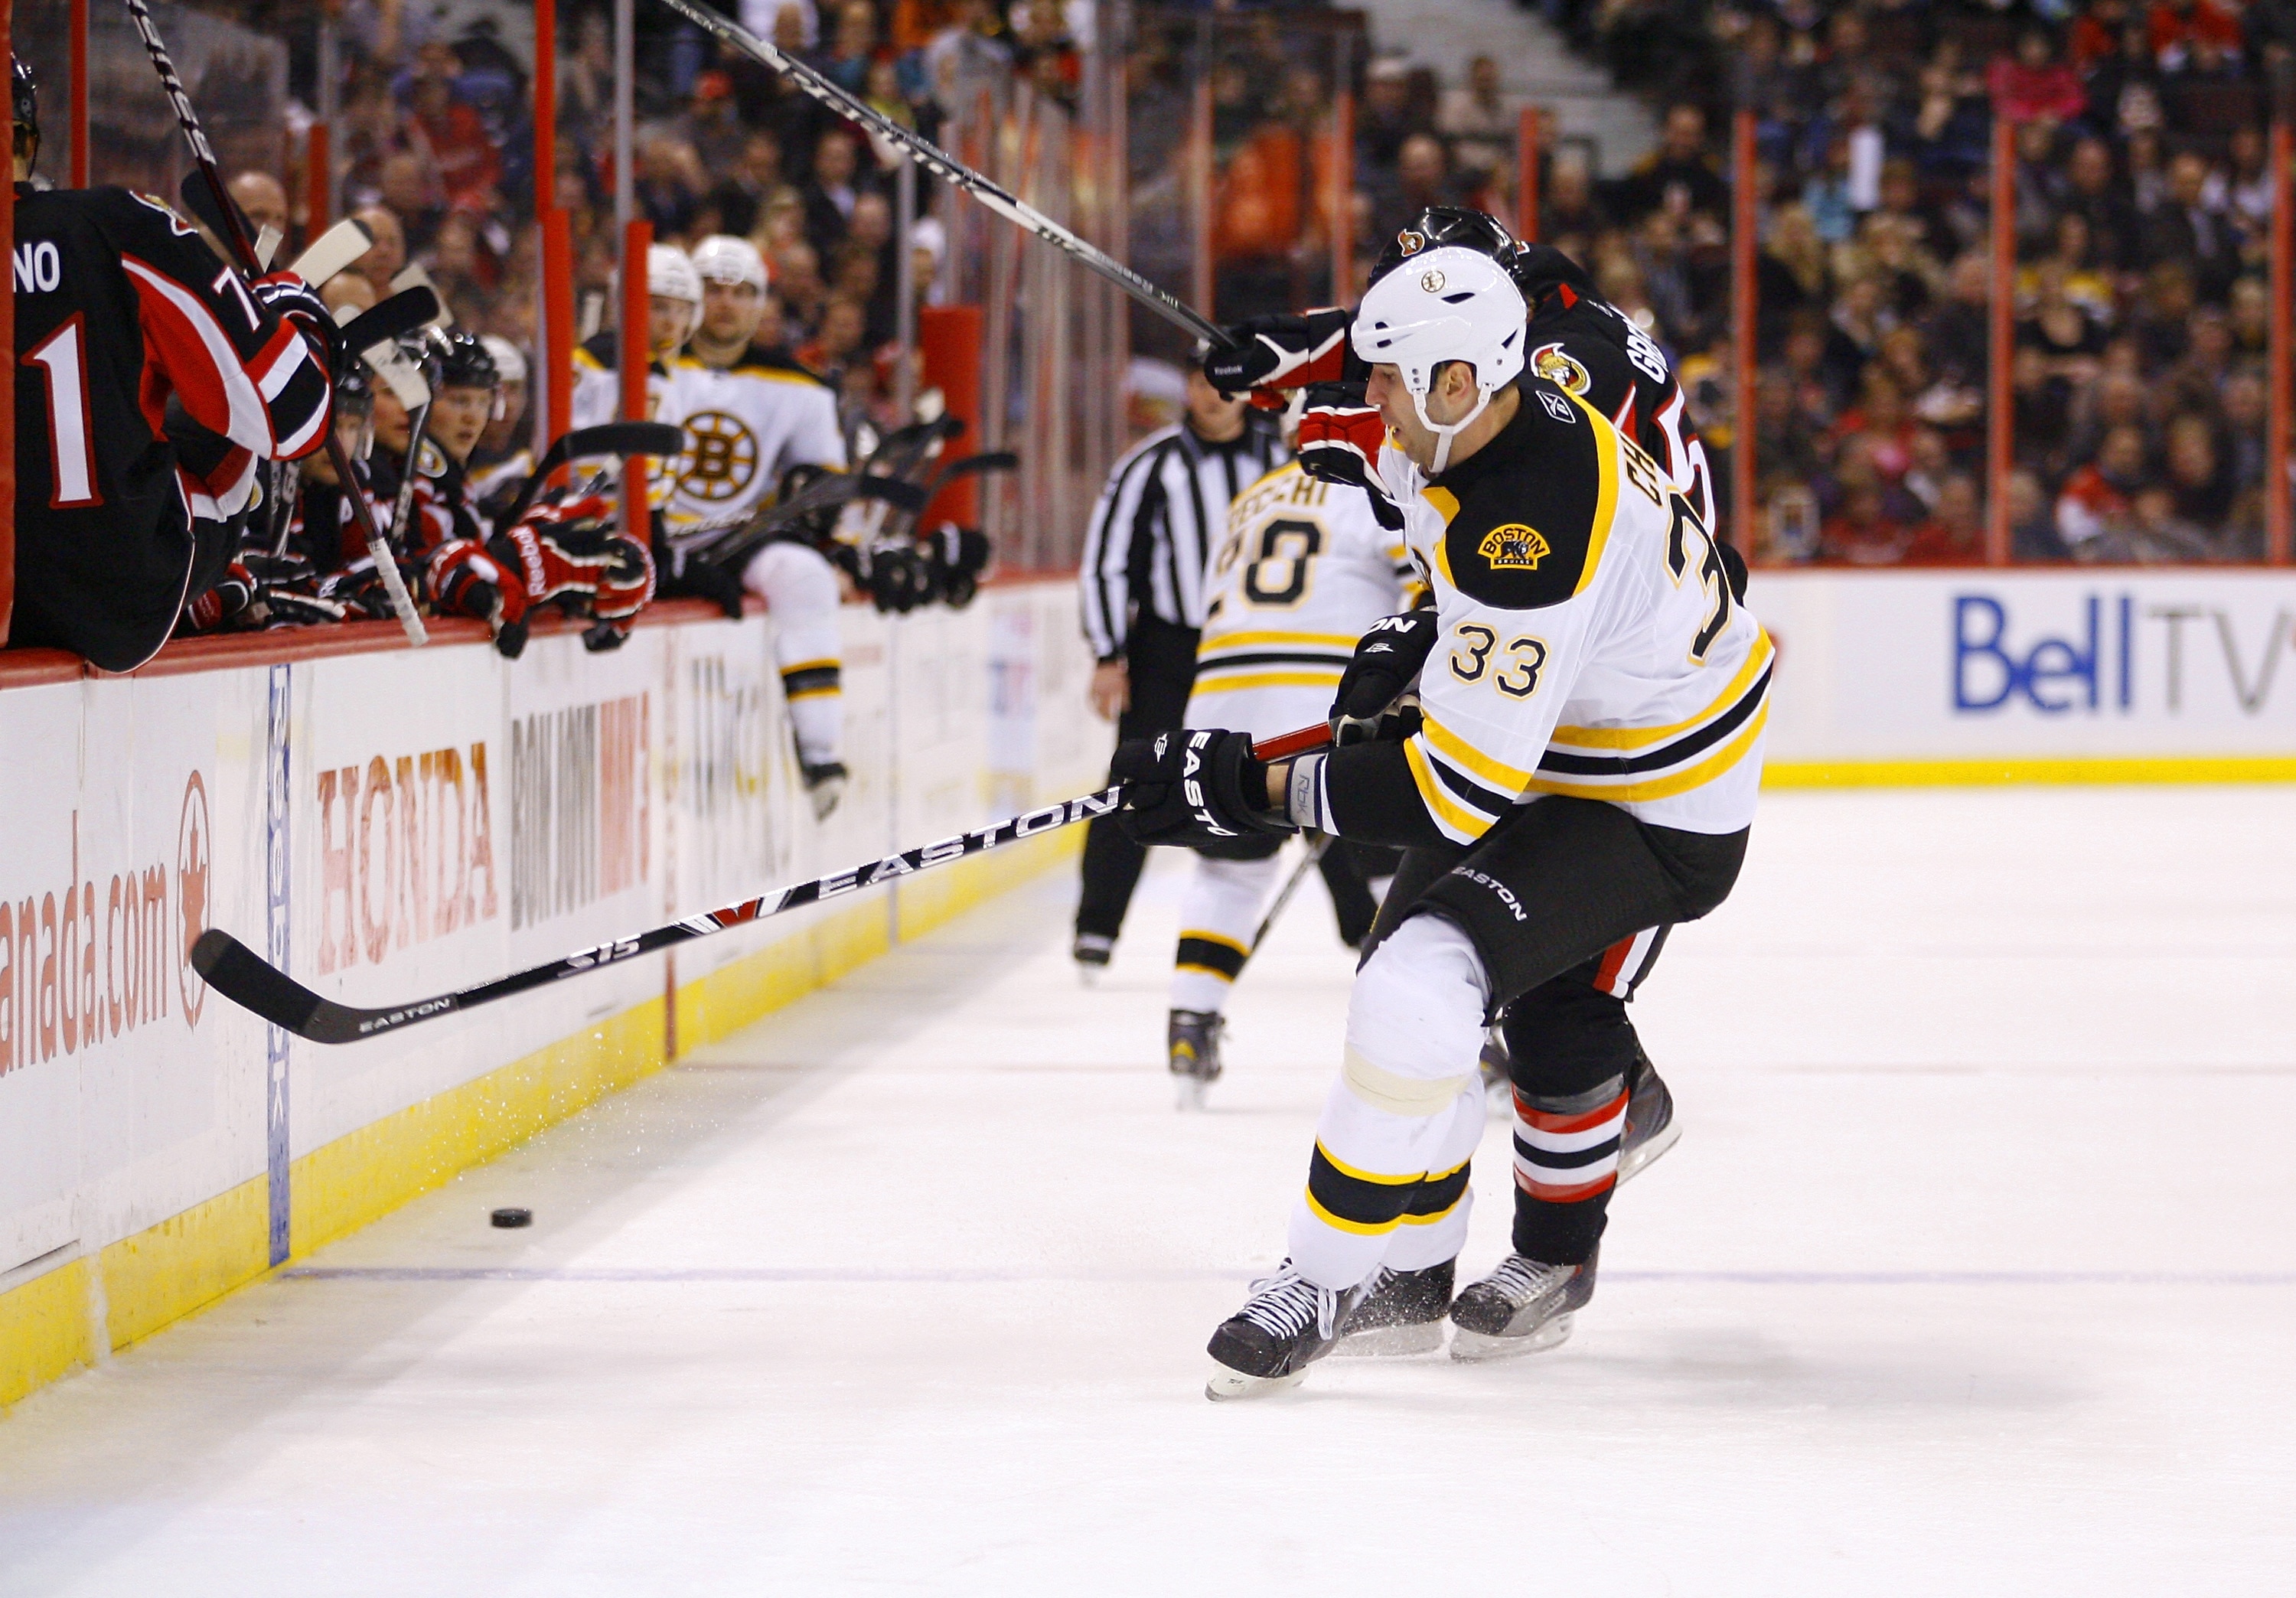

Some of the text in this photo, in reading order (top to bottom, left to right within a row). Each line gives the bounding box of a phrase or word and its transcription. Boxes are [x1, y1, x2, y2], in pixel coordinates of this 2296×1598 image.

[21, 311, 104, 510] 1
[1215, 365, 1243, 375] Reebok
[1483, 527, 1545, 555] BOSTON
[1448, 621, 1551, 703] 33
[1954, 594, 2135, 716] Bell
[318, 740, 497, 977] HONDA
[818, 786, 1120, 899] EASTON
[1452, 866, 1528, 921] EASTON
[359, 998, 450, 1033] EASTON
